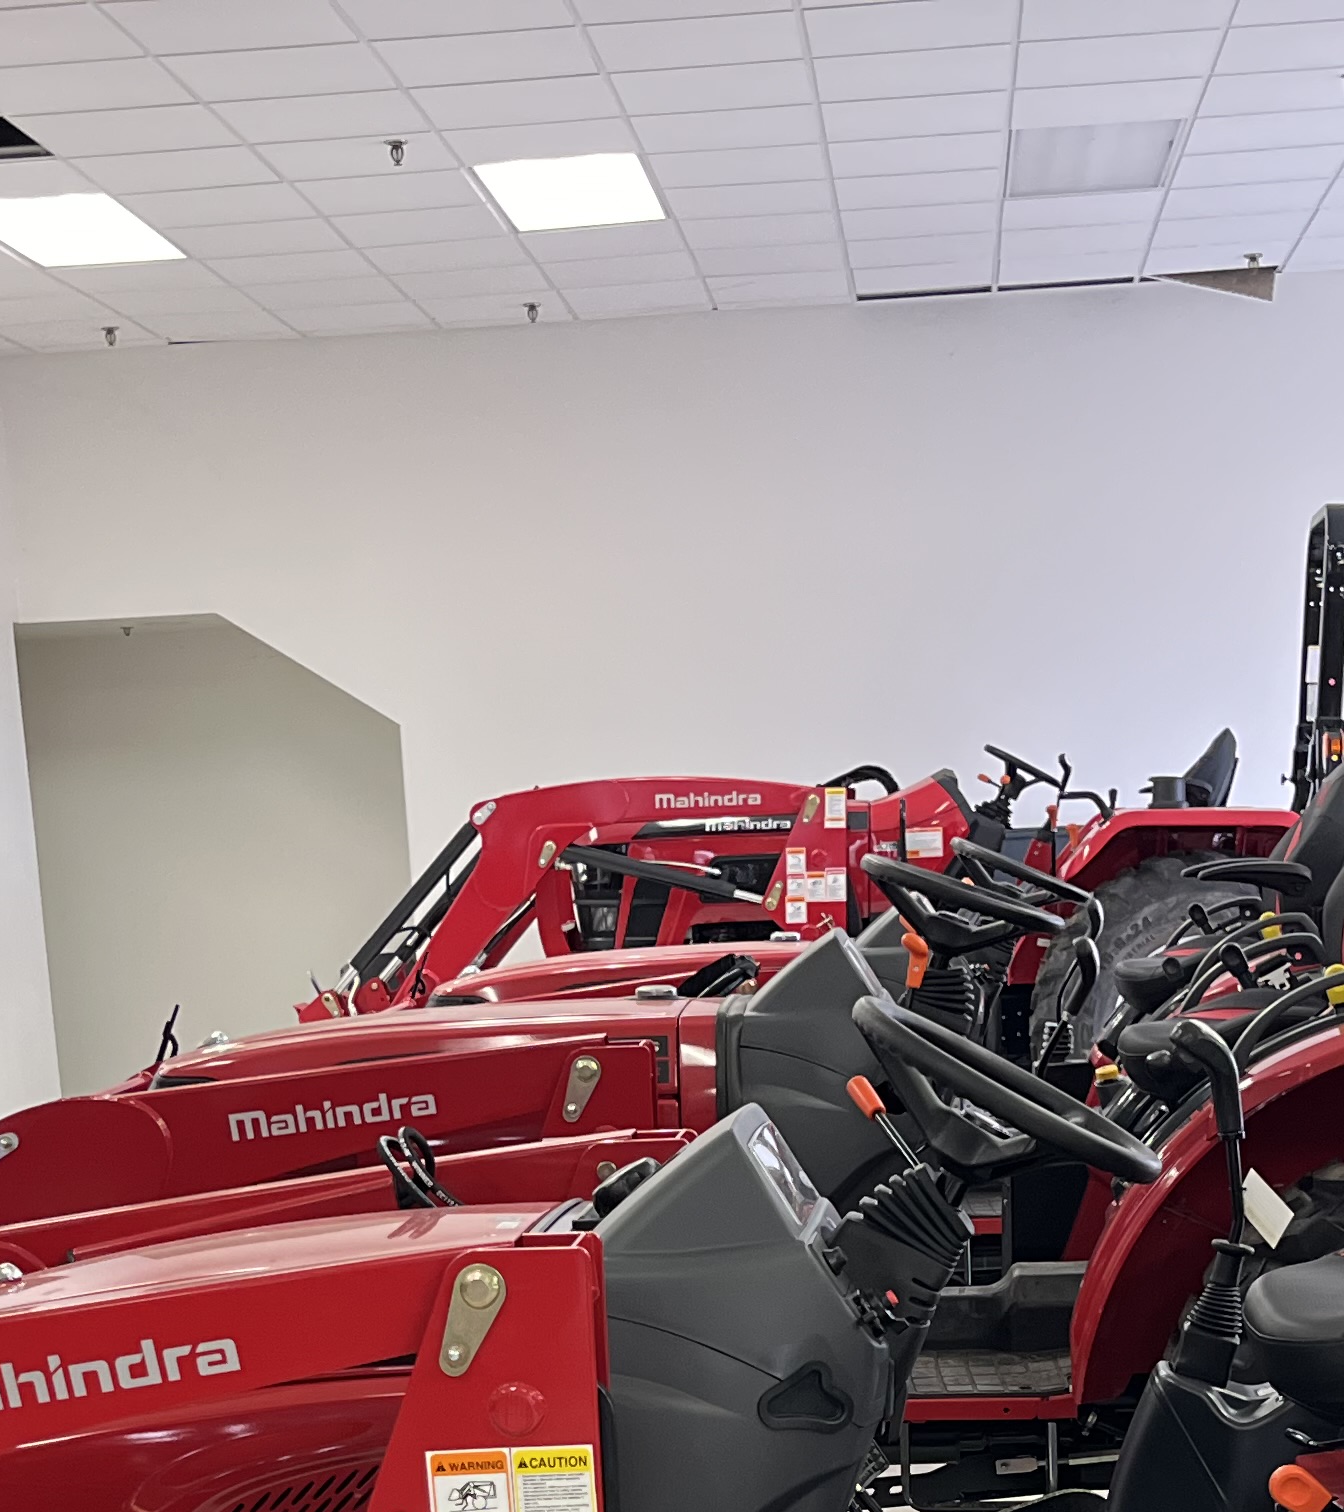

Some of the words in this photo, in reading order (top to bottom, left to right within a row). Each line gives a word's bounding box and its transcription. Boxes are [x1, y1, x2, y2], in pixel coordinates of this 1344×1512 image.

[228, 1093, 437, 1142] Mahindra
[448, 1459, 504, 1472] WARNING
[529, 1455, 588, 1469] CAUTION
